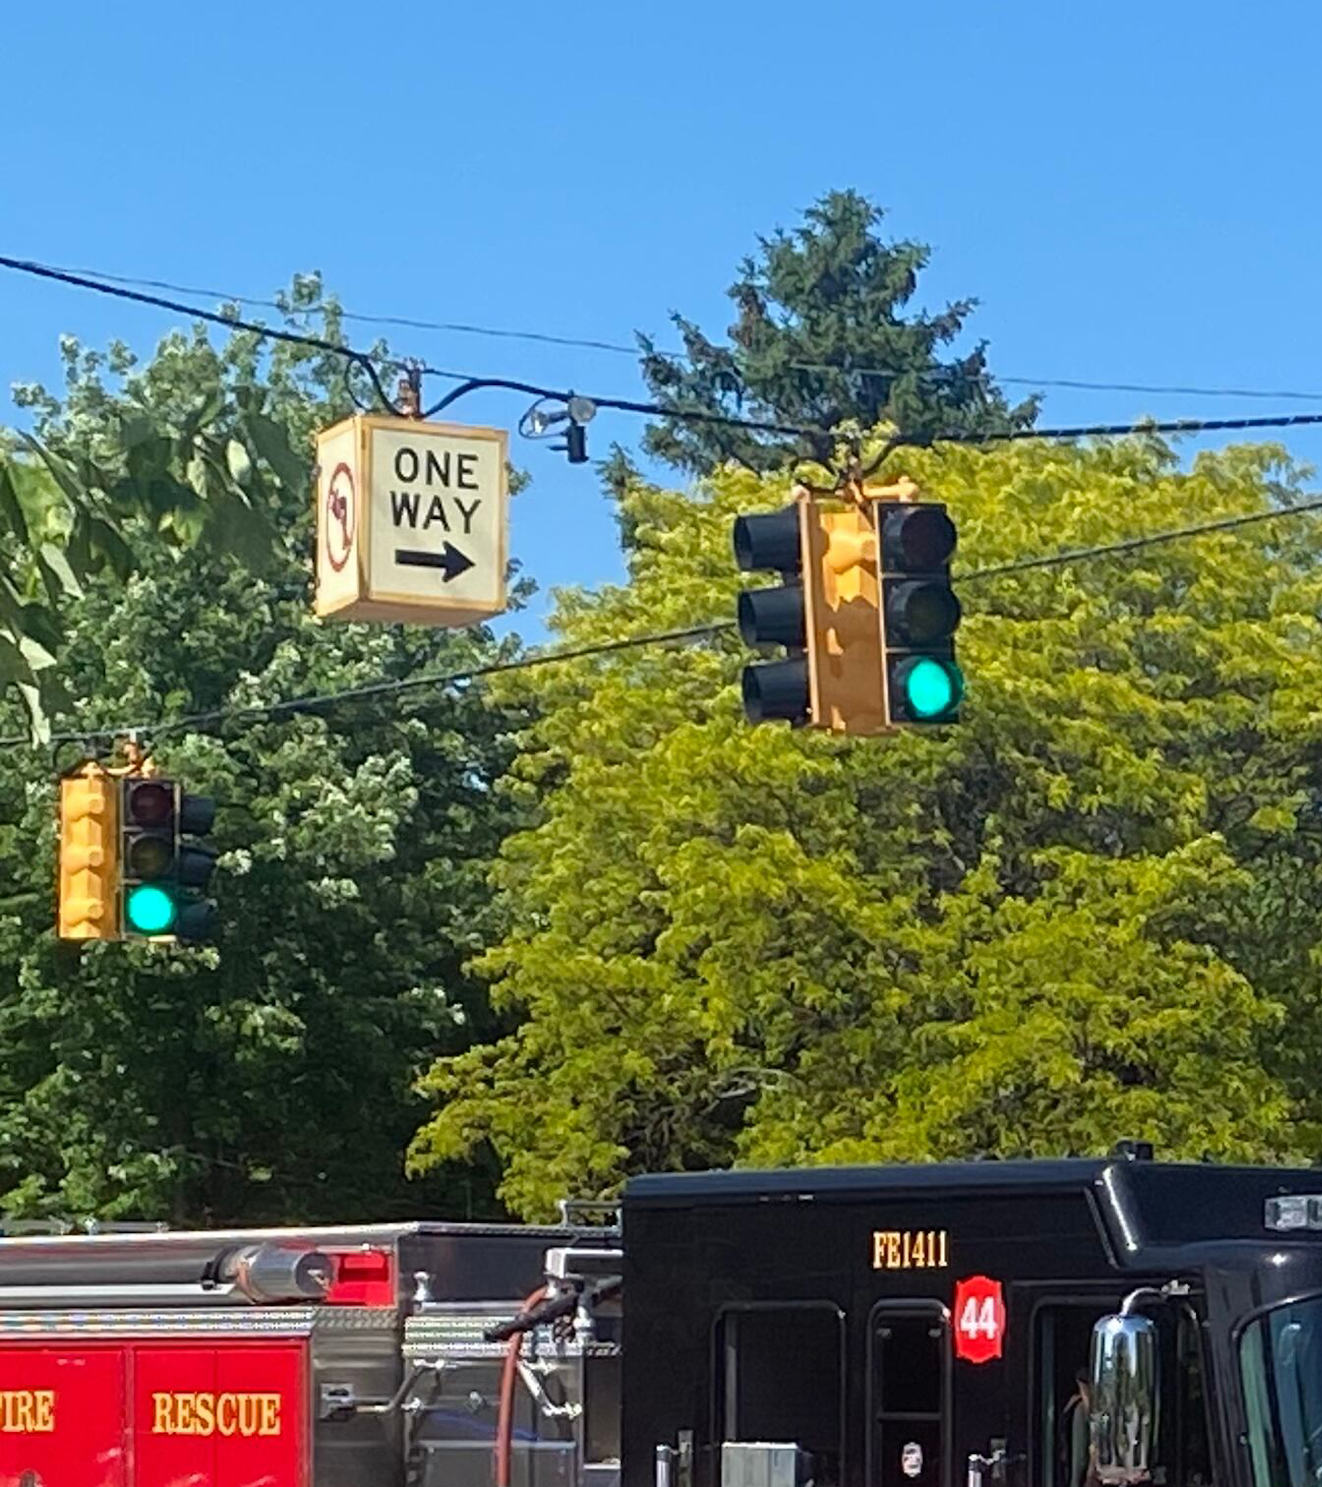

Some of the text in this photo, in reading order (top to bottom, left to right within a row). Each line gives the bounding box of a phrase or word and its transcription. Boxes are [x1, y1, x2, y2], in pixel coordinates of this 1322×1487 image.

[394, 447, 479, 490] ONE
[389, 491, 482, 534] WAY
[872, 1230, 948, 1269] FE1411
[959, 1295, 998, 1340] 44
[0, 1390, 54, 1432] IRE
[152, 1391, 281, 1436] RESCUE
